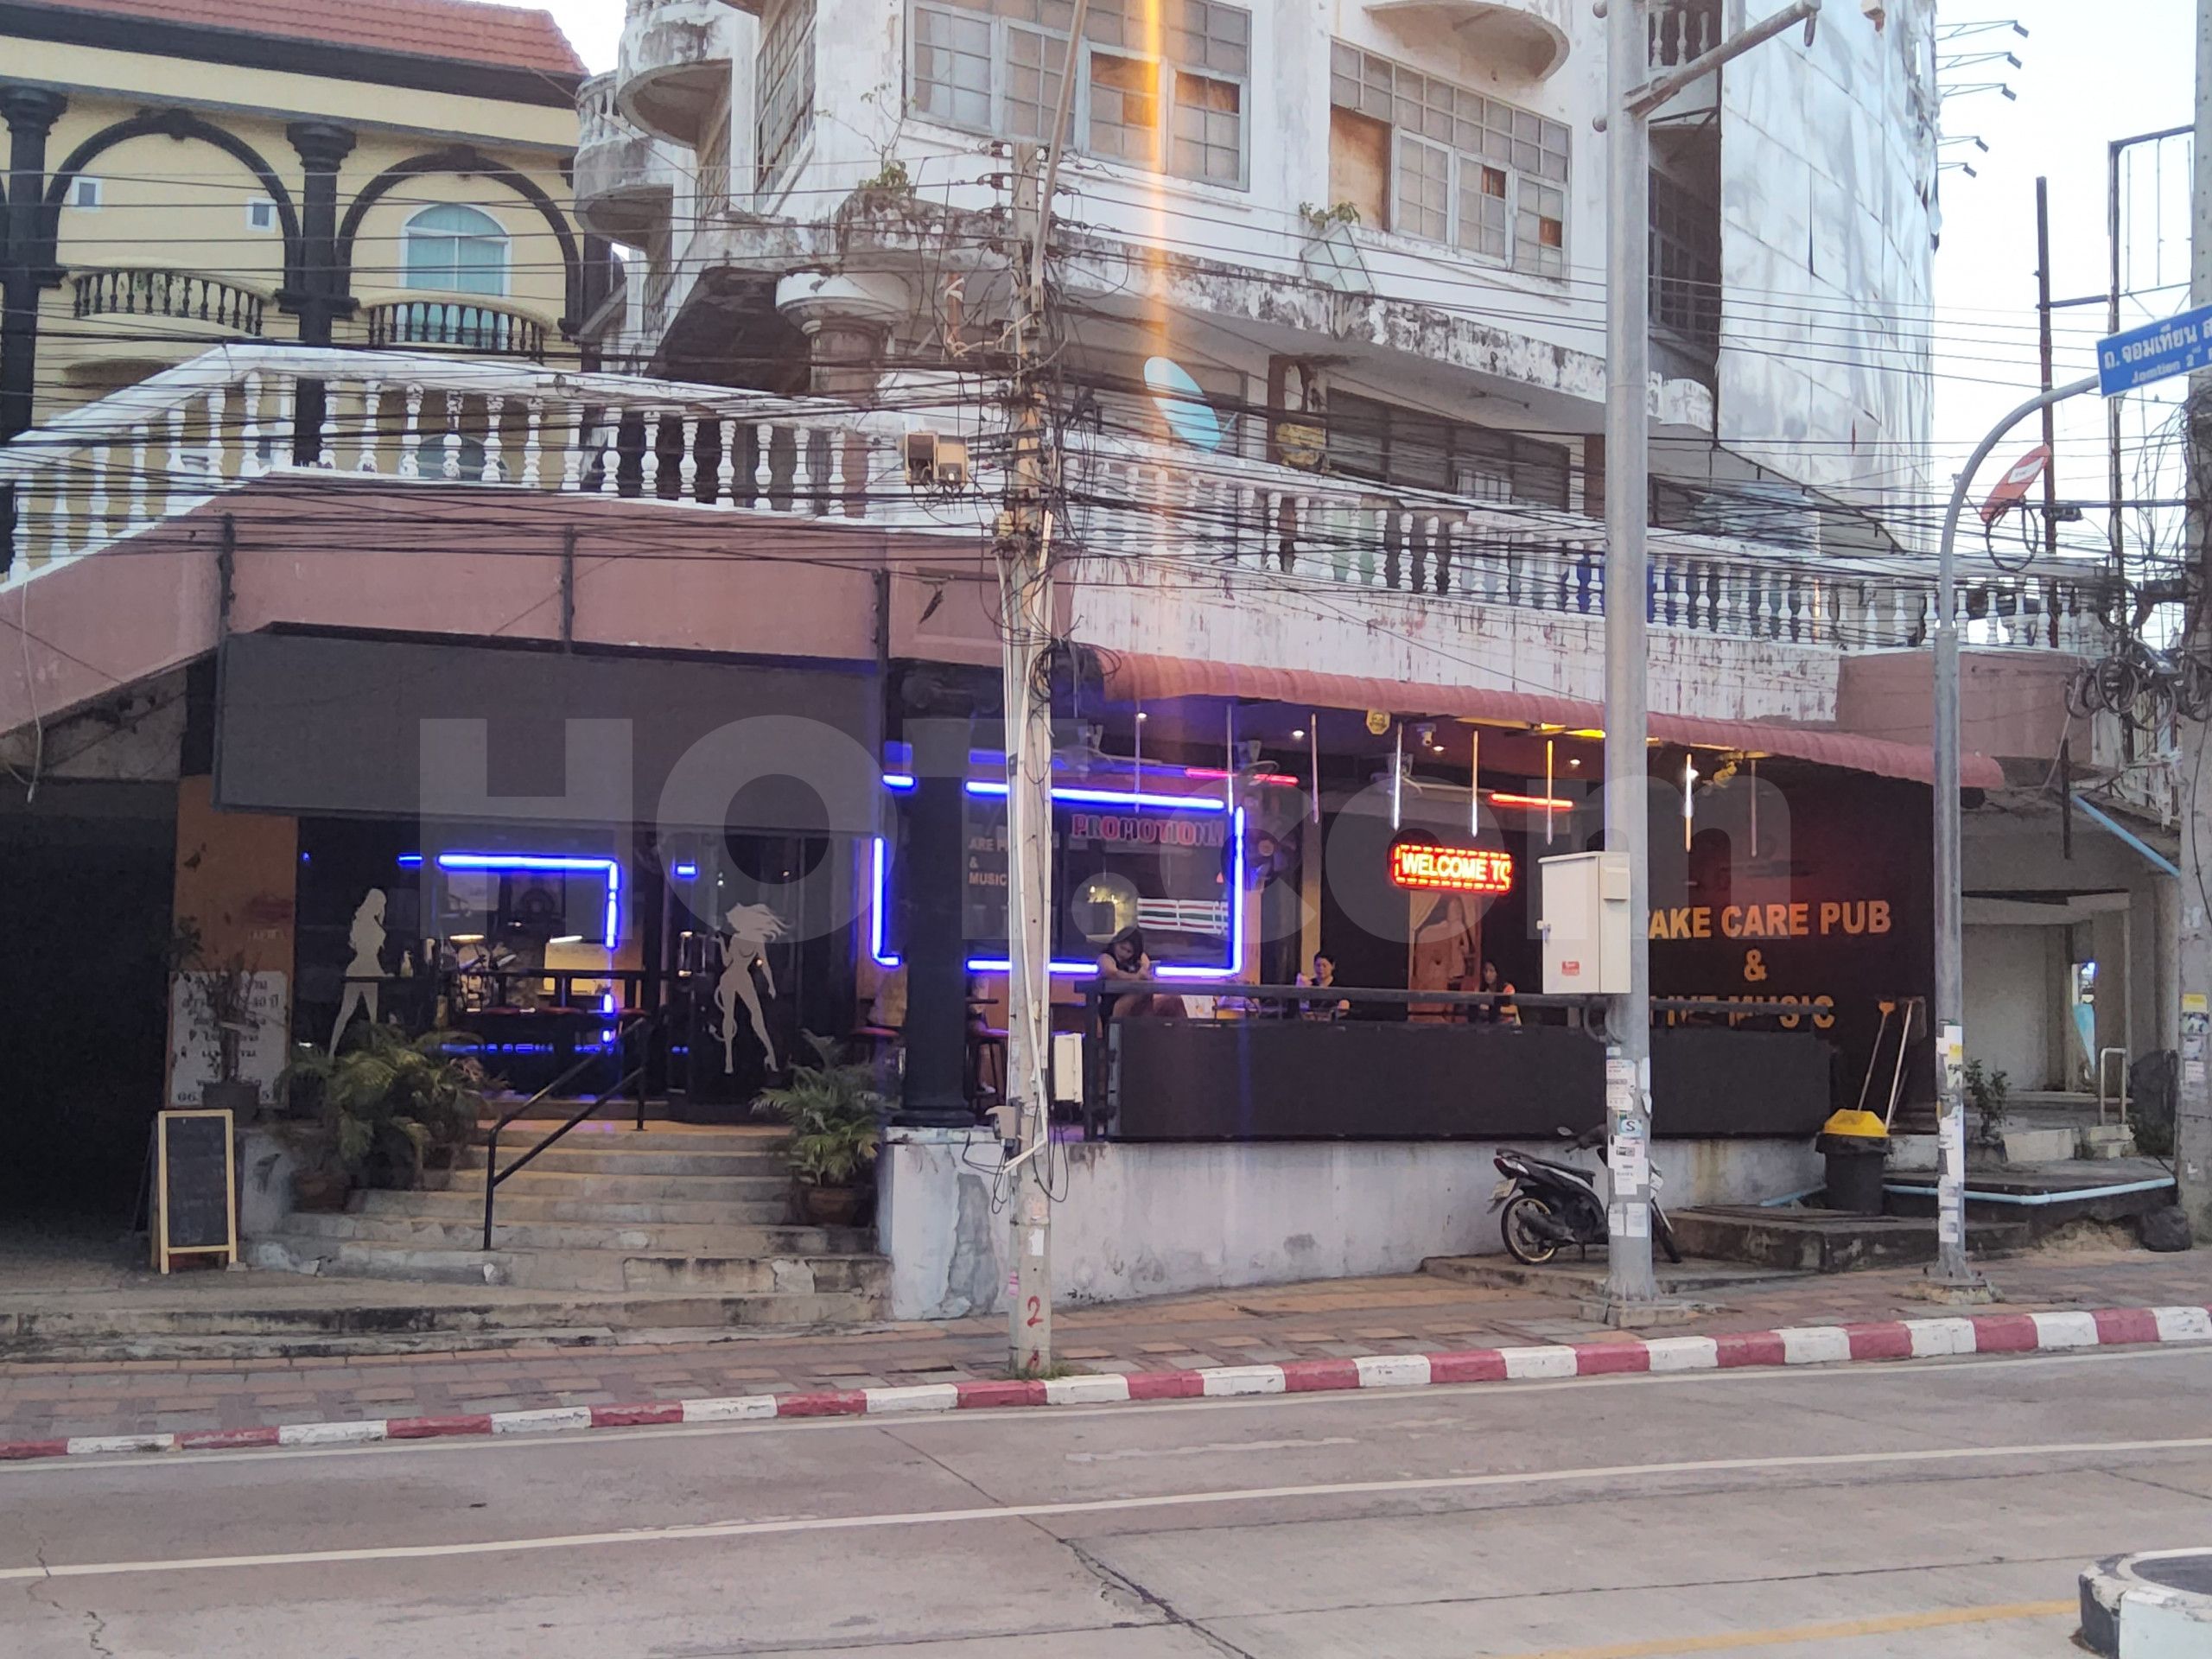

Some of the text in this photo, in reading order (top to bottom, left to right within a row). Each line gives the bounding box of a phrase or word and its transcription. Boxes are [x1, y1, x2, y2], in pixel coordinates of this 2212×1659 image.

[2121, 323, 2197, 363] จอมเทียน
[969, 872, 1008, 887] MUSIC
[1402, 852, 1488, 880] WELCOME
[1648, 899, 1892, 940] AKE CARE PUB
[1744, 949, 1768, 982] &
[1728, 995, 1835, 1028] MSC
[1027, 1295, 1044, 1327] 2
